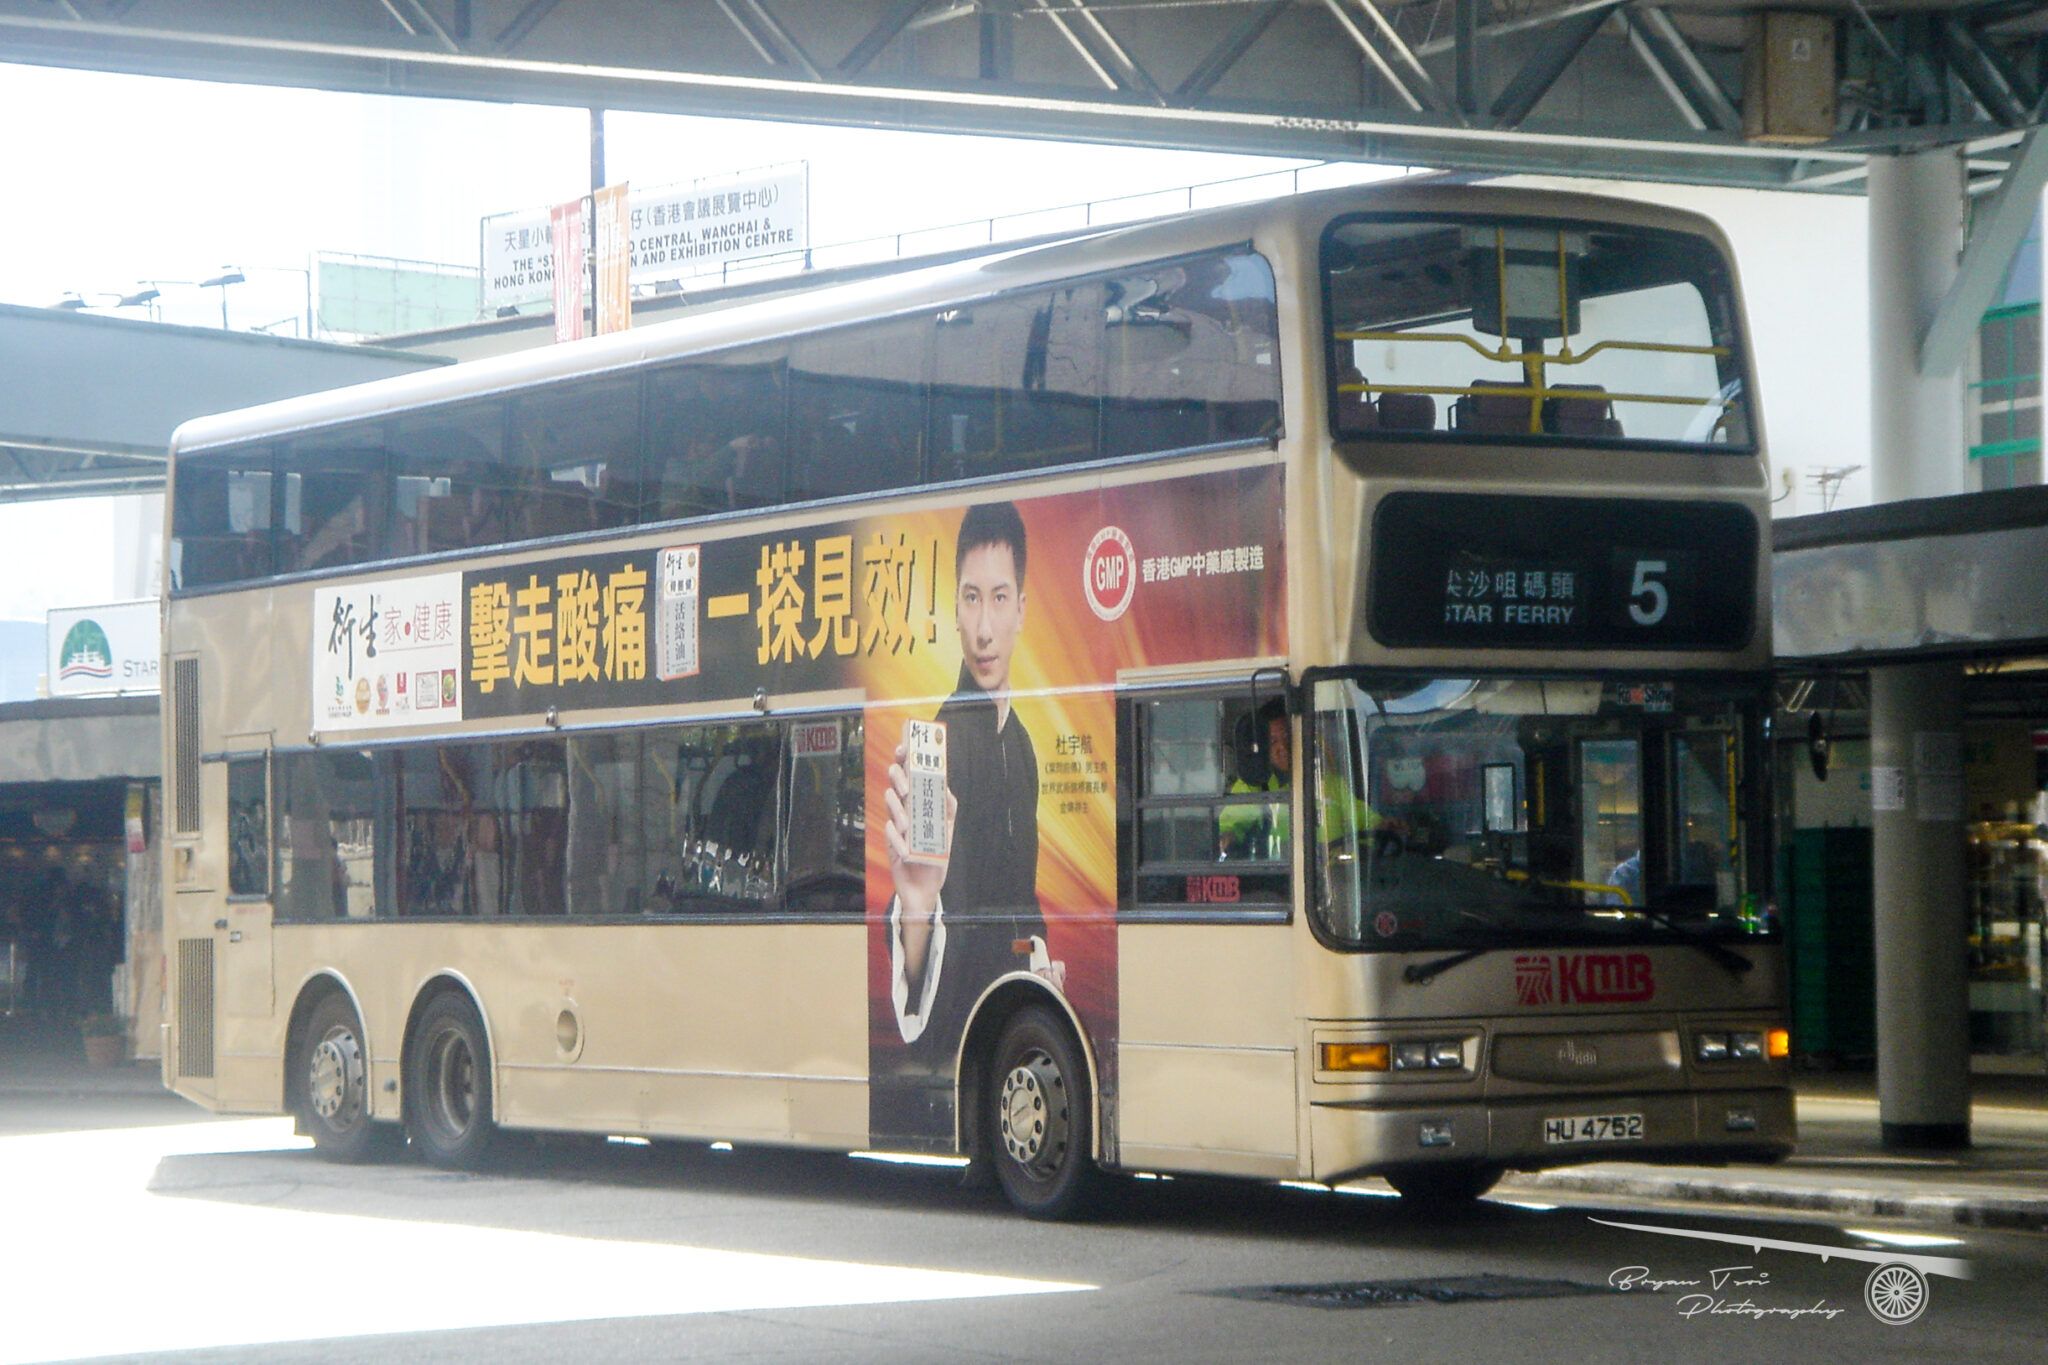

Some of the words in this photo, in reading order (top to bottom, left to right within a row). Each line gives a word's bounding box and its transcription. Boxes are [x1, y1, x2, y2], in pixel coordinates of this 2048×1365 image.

[494, 274, 524, 289] HONG
[529, 269, 555, 284] KON
[643, 251, 666, 266] AND
[671, 238, 740, 261] EXHIBITION
[745, 228, 794, 248] CENTRE
[513, 258, 533, 271] THE
[702, 219, 758, 240] WANCHAI
[763, 217, 771, 231] &
[1096, 555, 1125, 591] GMP
[1628, 560, 1669, 626] 5
[470, 563, 648, 694] 擊走酸痛
[1504, 604, 1575, 625] FERRY
[1202, 876, 1240, 902] KMB
[1558, 953, 1656, 1005] KMB
[1546, 1119, 1575, 1141] HU
[1581, 1115, 1643, 1140] 4752
